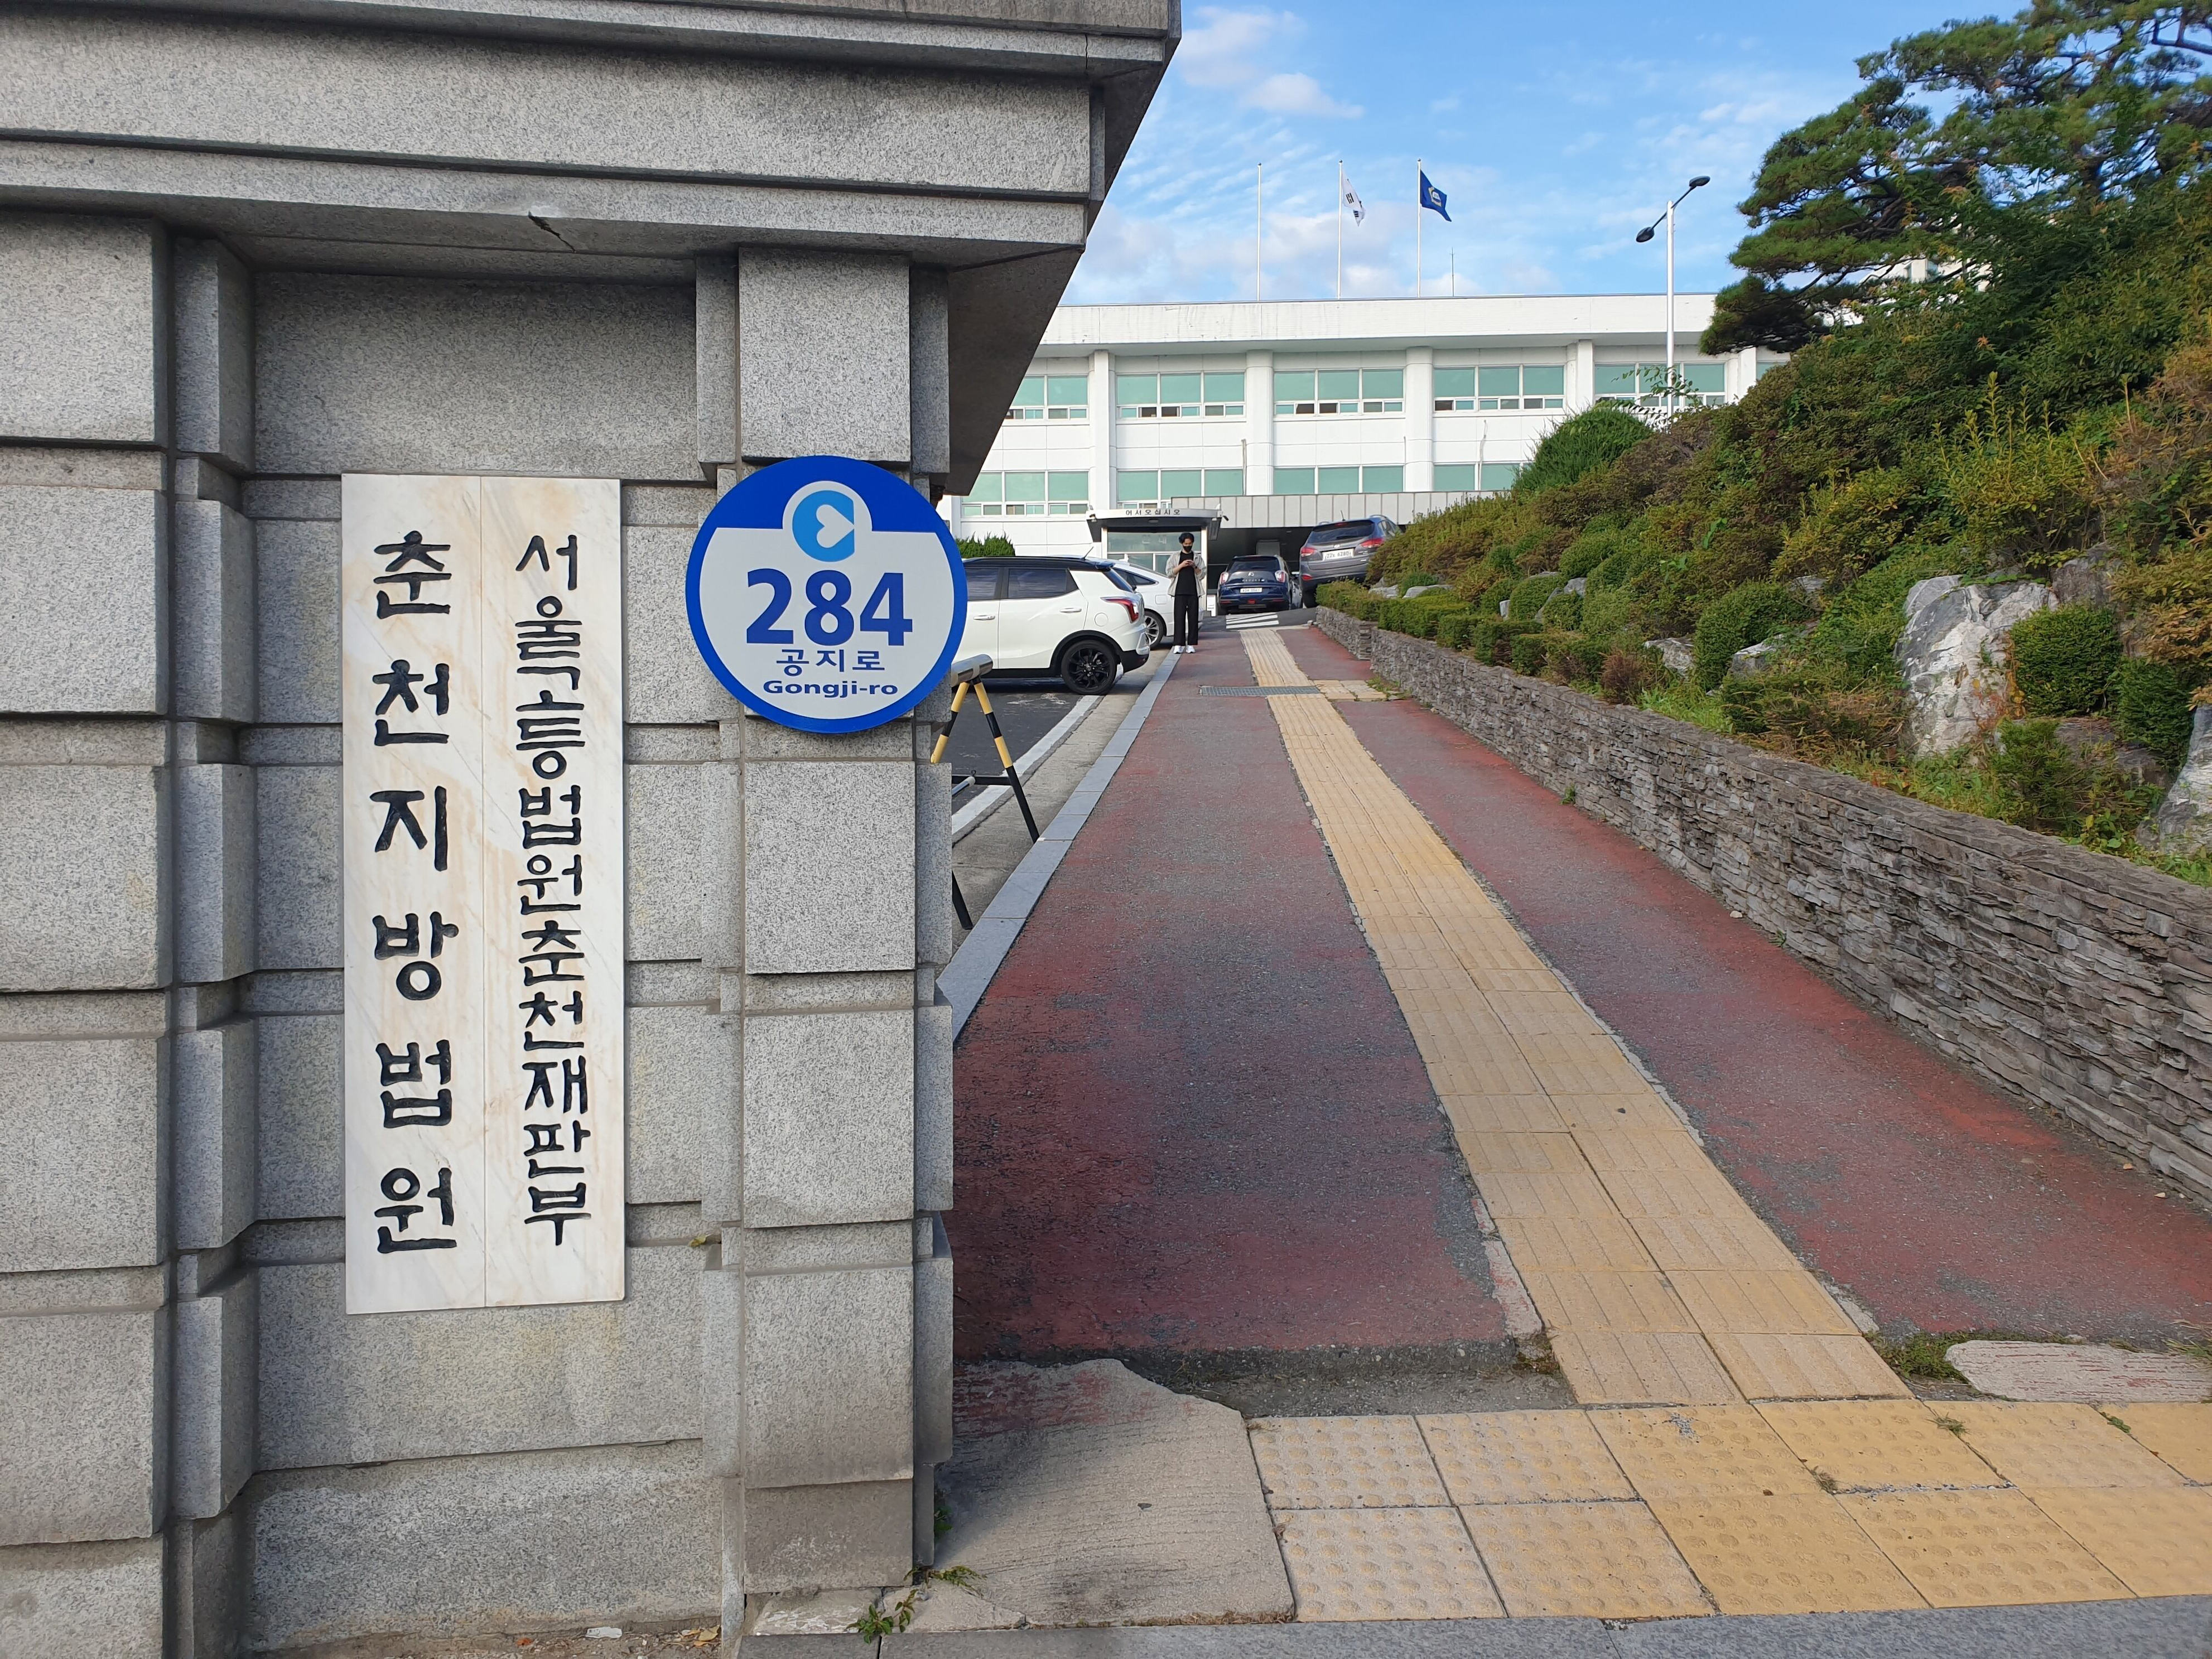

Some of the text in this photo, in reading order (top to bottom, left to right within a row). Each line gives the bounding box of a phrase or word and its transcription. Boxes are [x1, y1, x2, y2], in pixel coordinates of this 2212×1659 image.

[746, 568, 913, 646] 284
[763, 680, 898, 698] Gongji-ro
[776, 649, 885, 677] 공지로
[370, 530, 459, 1254] 춘천지방법원
[515, 534, 591, 1246] 서울고등법원춘천재판부
